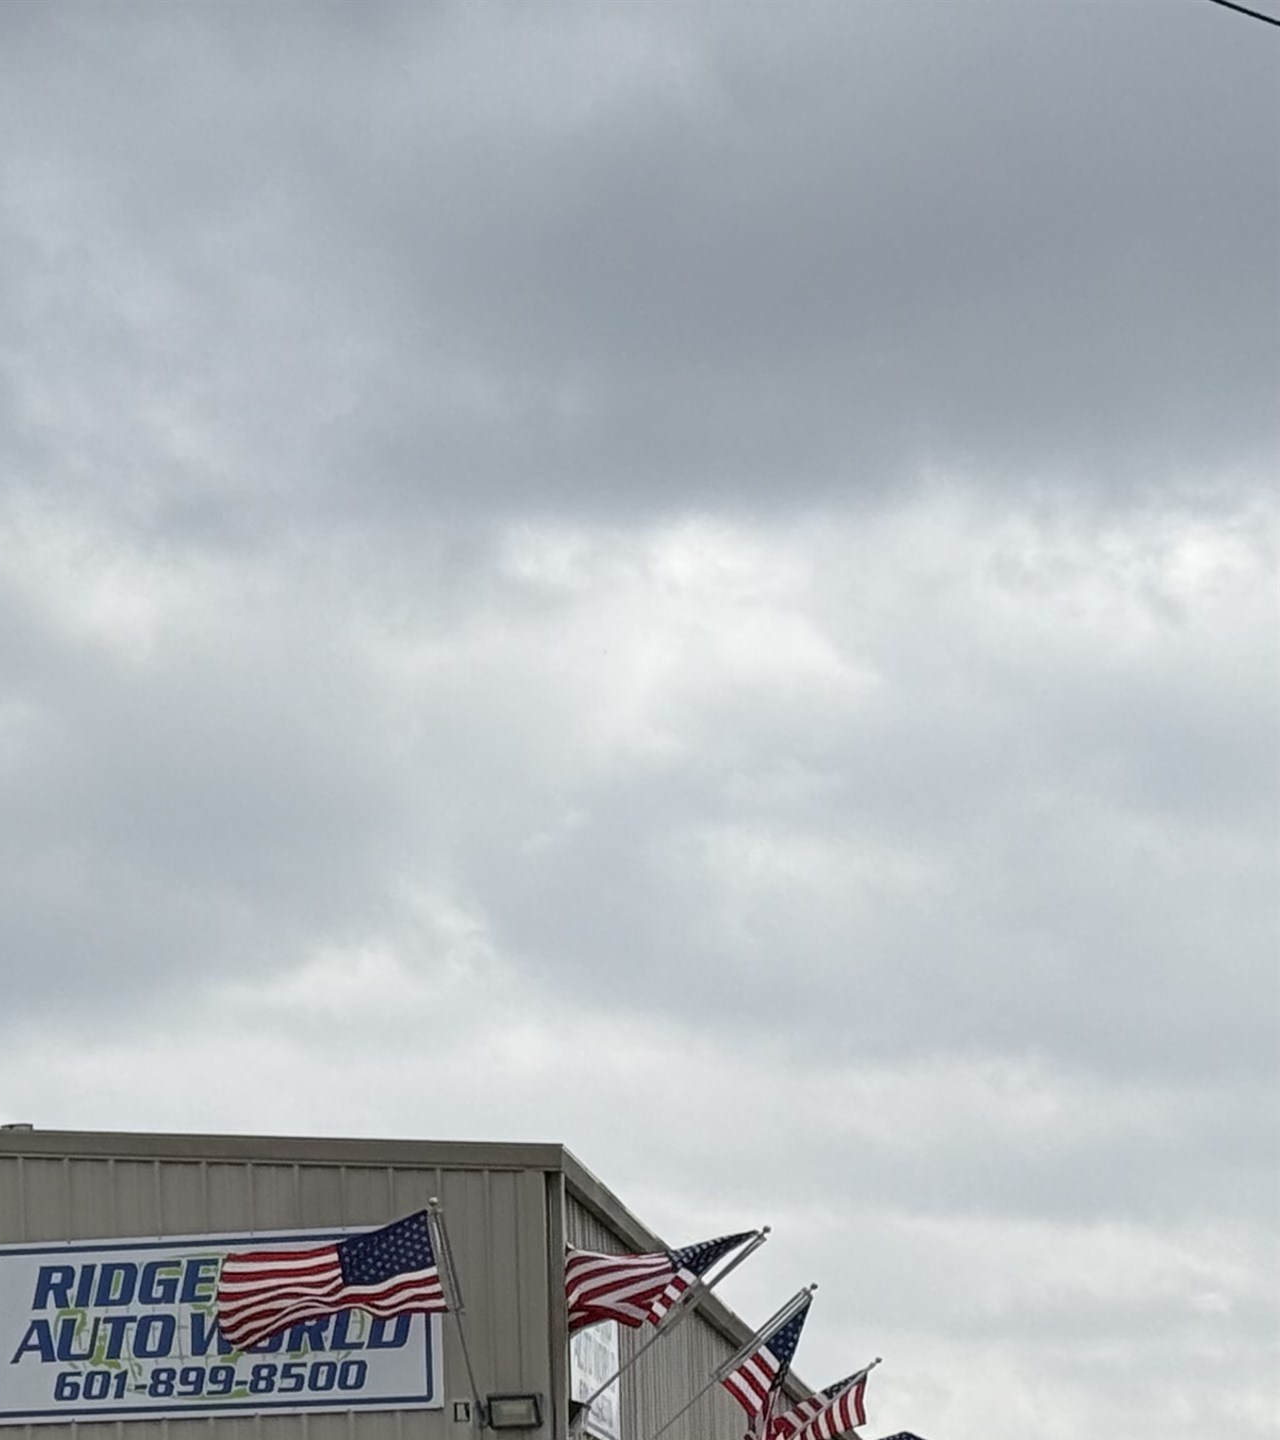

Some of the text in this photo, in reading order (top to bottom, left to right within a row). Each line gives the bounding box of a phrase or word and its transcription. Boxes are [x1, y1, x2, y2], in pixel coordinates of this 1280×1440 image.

[31, 1257, 220, 1311] RIDGE
[9, 1313, 177, 1365] AUTO
[53, 1360, 368, 1402] 601-899-8500
